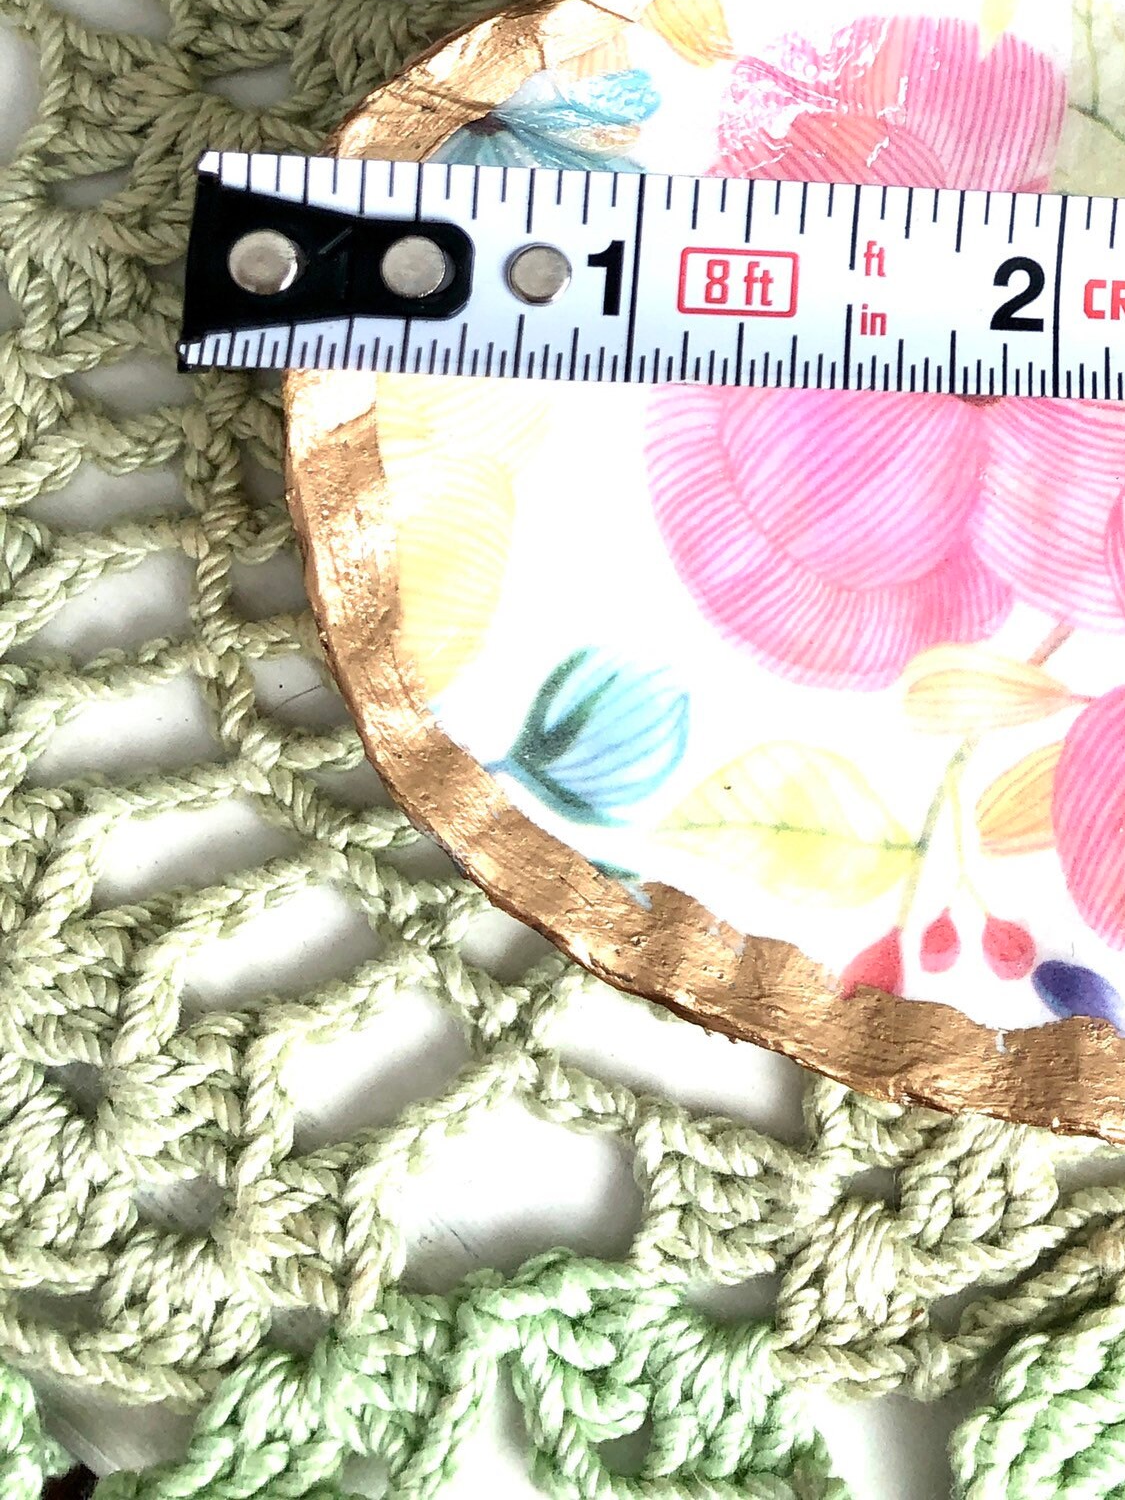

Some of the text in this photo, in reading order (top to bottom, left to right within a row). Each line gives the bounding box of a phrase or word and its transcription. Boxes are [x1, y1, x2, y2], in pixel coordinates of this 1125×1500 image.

[587, 239, 626, 317] 1
[703, 258, 774, 307] 8 ft
[863, 240, 886, 278] ft
[989, 256, 1045, 333] 2
[860, 303, 887, 336] in
